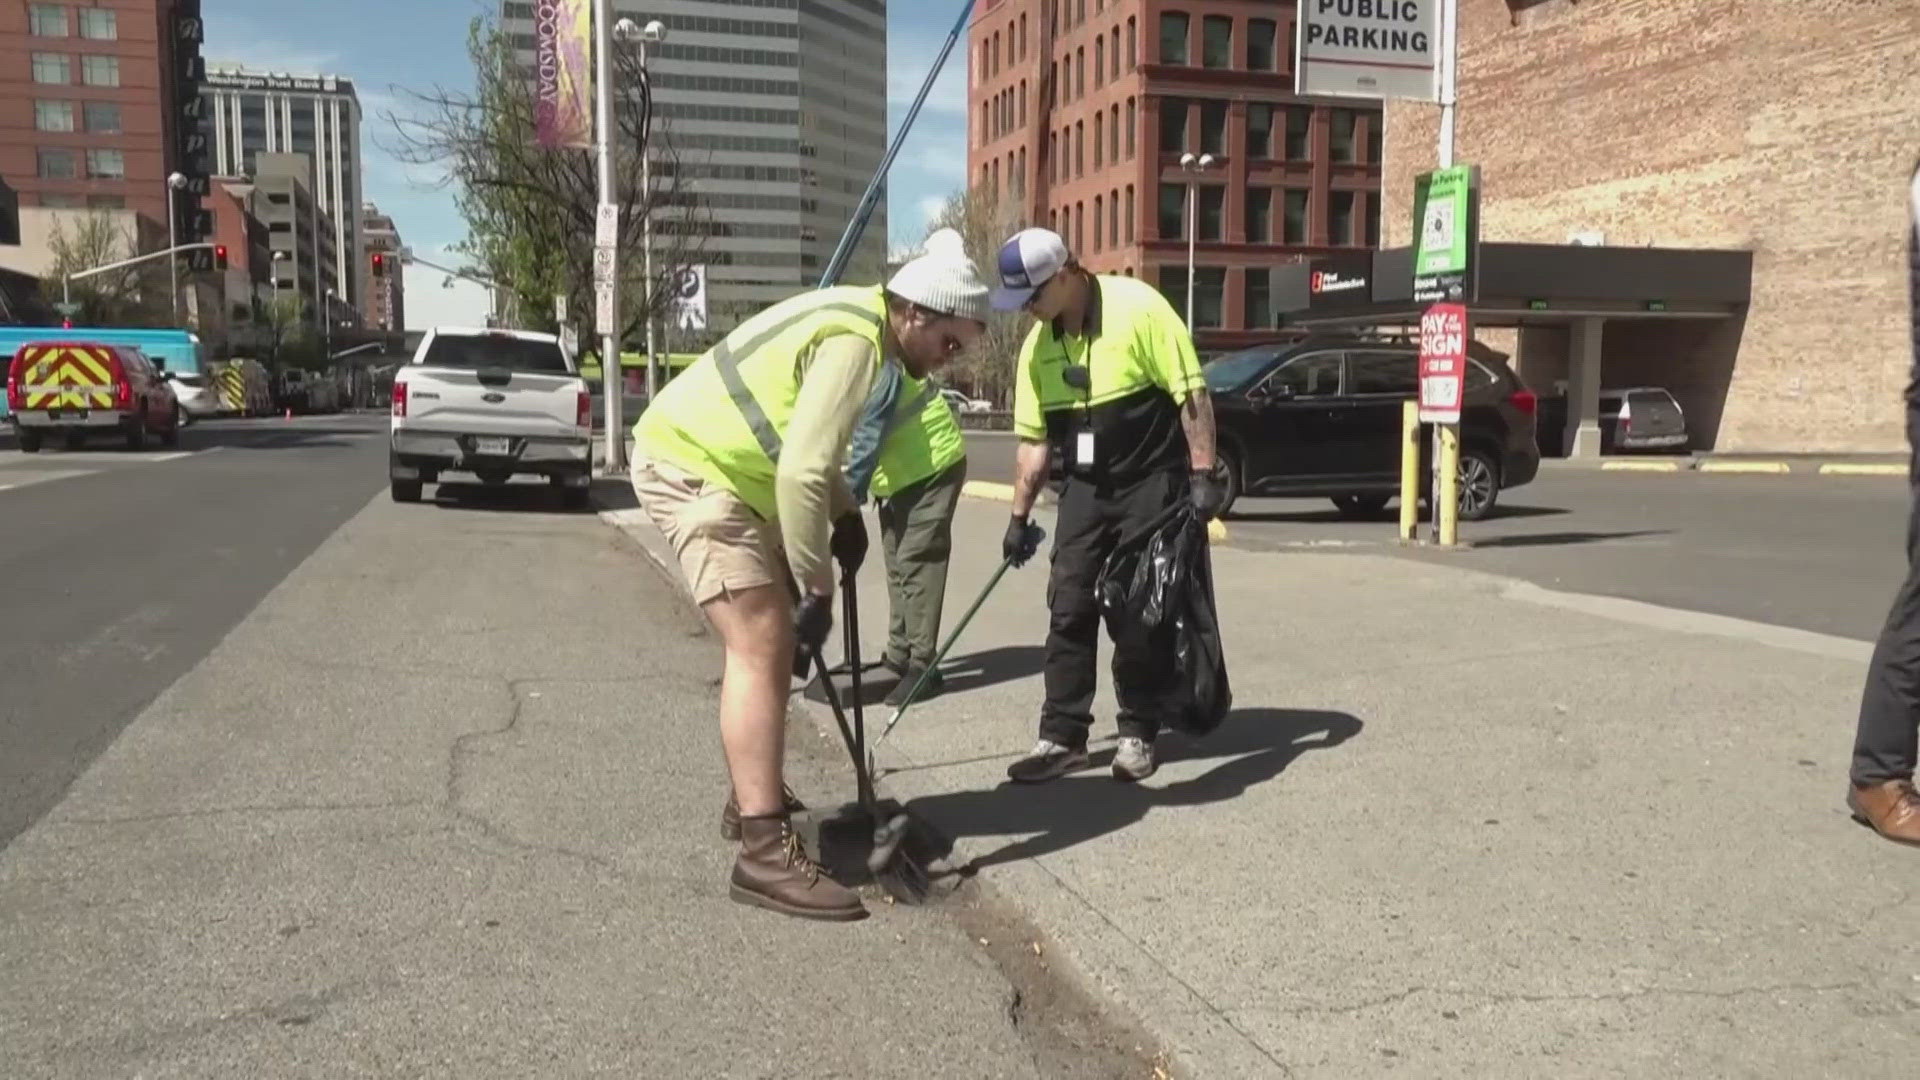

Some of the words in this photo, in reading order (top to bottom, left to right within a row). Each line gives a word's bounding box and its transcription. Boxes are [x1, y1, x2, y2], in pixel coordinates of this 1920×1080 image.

[1318, 0, 1418, 22] PUBLIC
[1307, 23, 1427, 53] PARKING
[267, 79, 291, 88] Trust
[294, 80, 320, 89] Bank
[1422, 313, 1447, 334] PAY
[1421, 334, 1463, 357] SIGN
